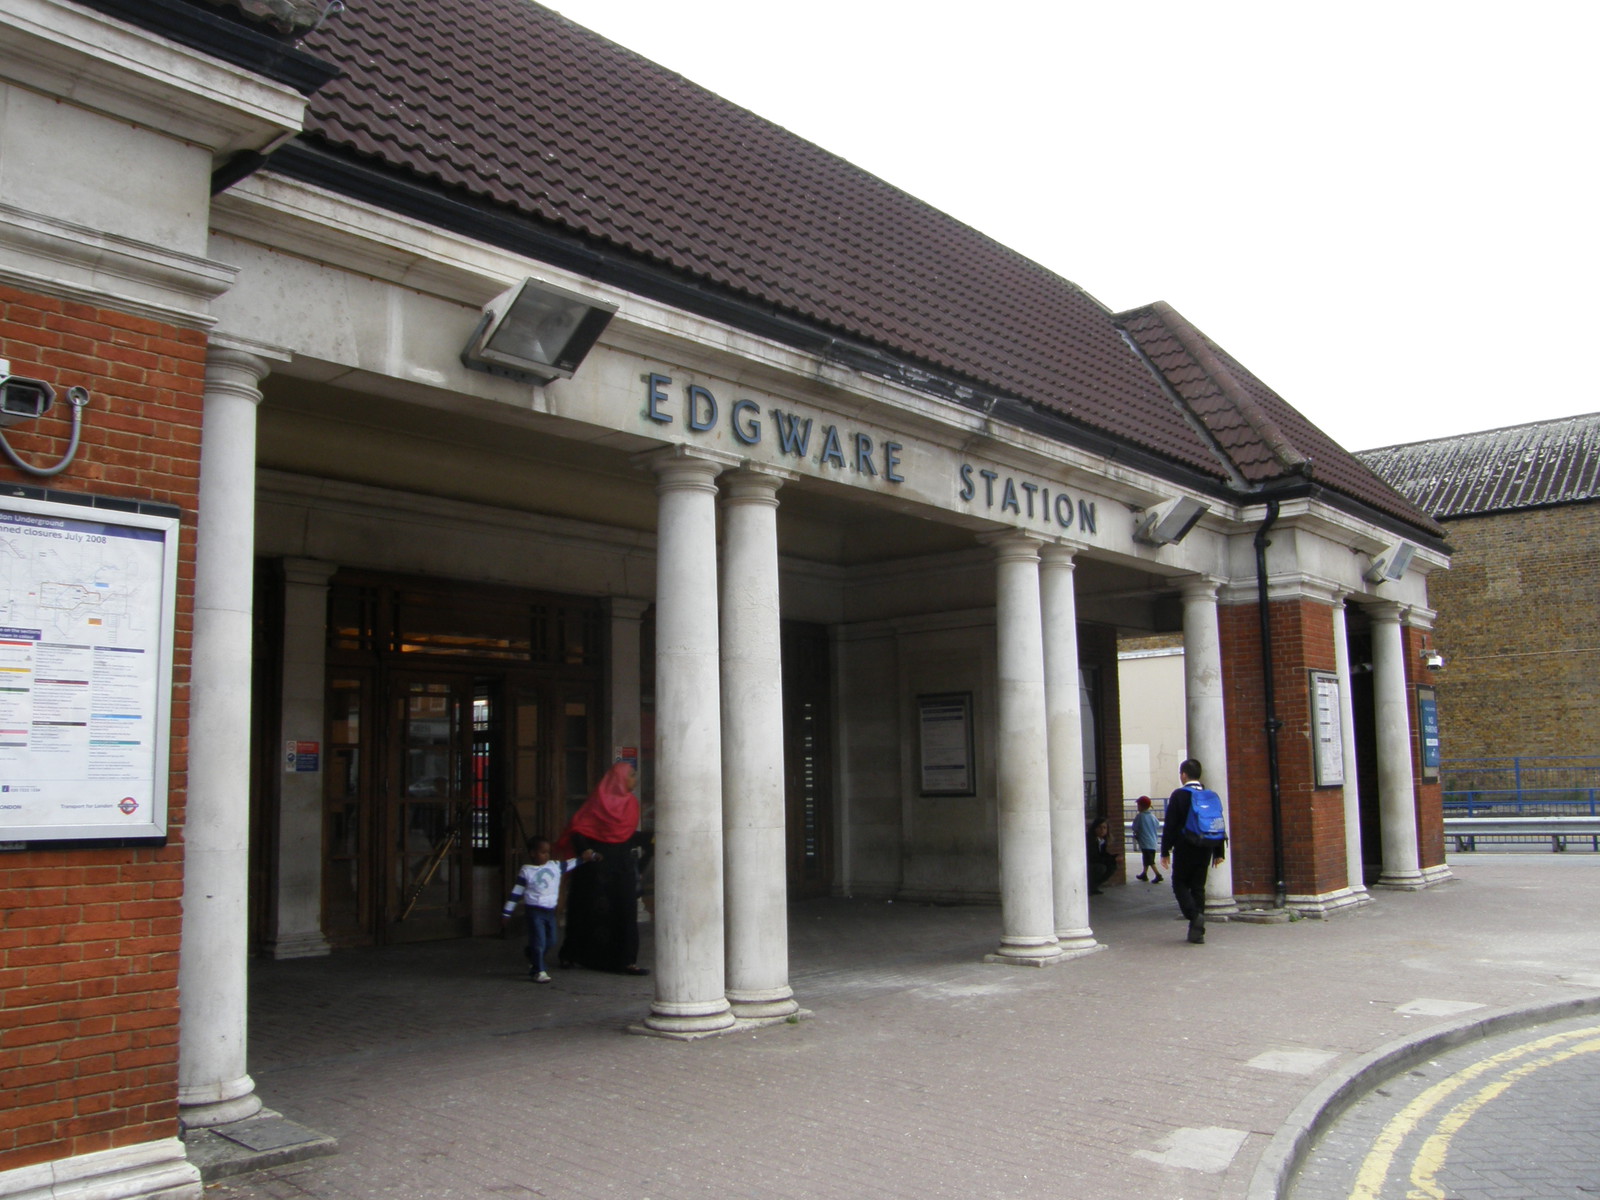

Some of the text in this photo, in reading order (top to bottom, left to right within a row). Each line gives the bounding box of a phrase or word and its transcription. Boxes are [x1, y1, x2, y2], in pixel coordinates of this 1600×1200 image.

[649, 371, 1097, 534] EDGWARE STATION
[14, 514, 64, 528] Underground
[24, 527, 62, 539] closures
[65, 532, 83, 543] July
[86, 534, 107, 544] 2008
